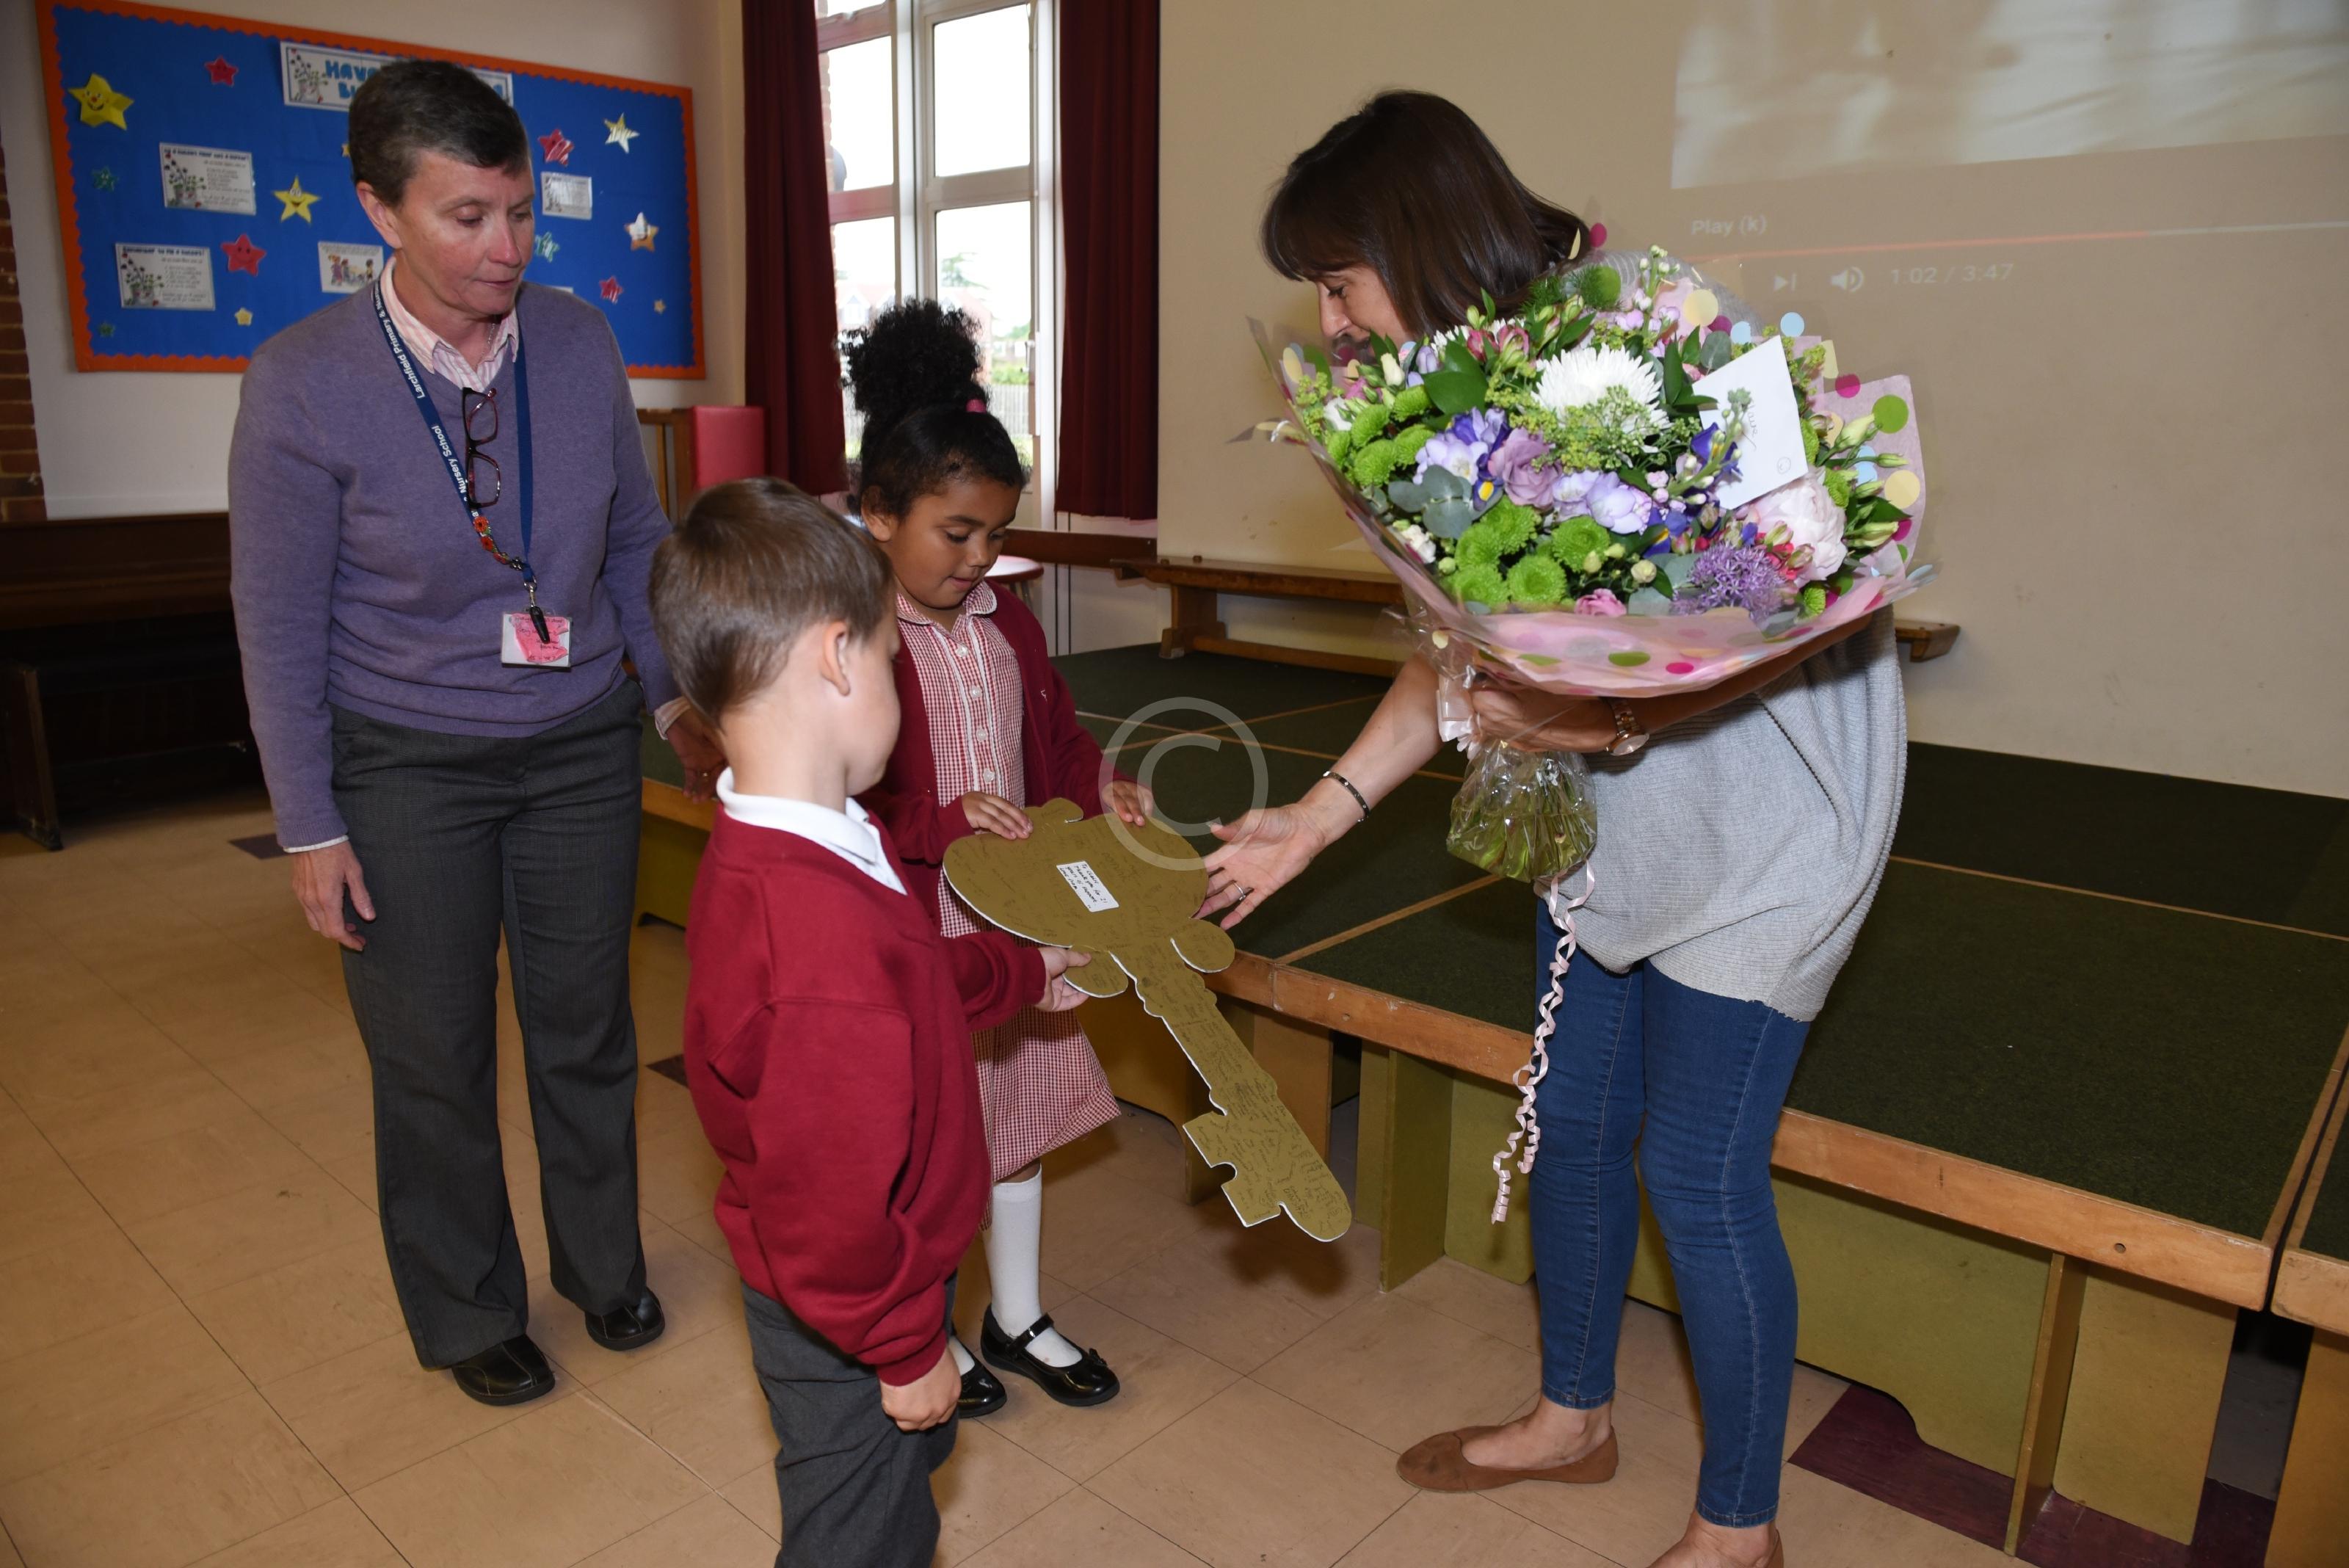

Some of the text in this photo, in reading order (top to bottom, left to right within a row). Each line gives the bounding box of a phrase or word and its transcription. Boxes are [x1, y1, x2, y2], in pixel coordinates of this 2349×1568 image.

[1691, 214, 1767, 237] Play (k)
[1890, 267, 1938, 284] 1:02
[1961, 264, 2014, 282] 3:47
[382, 319, 401, 355] Primary
[398, 355, 426, 399] Larchfield
[431, 425, 467, 493] Nursery School
